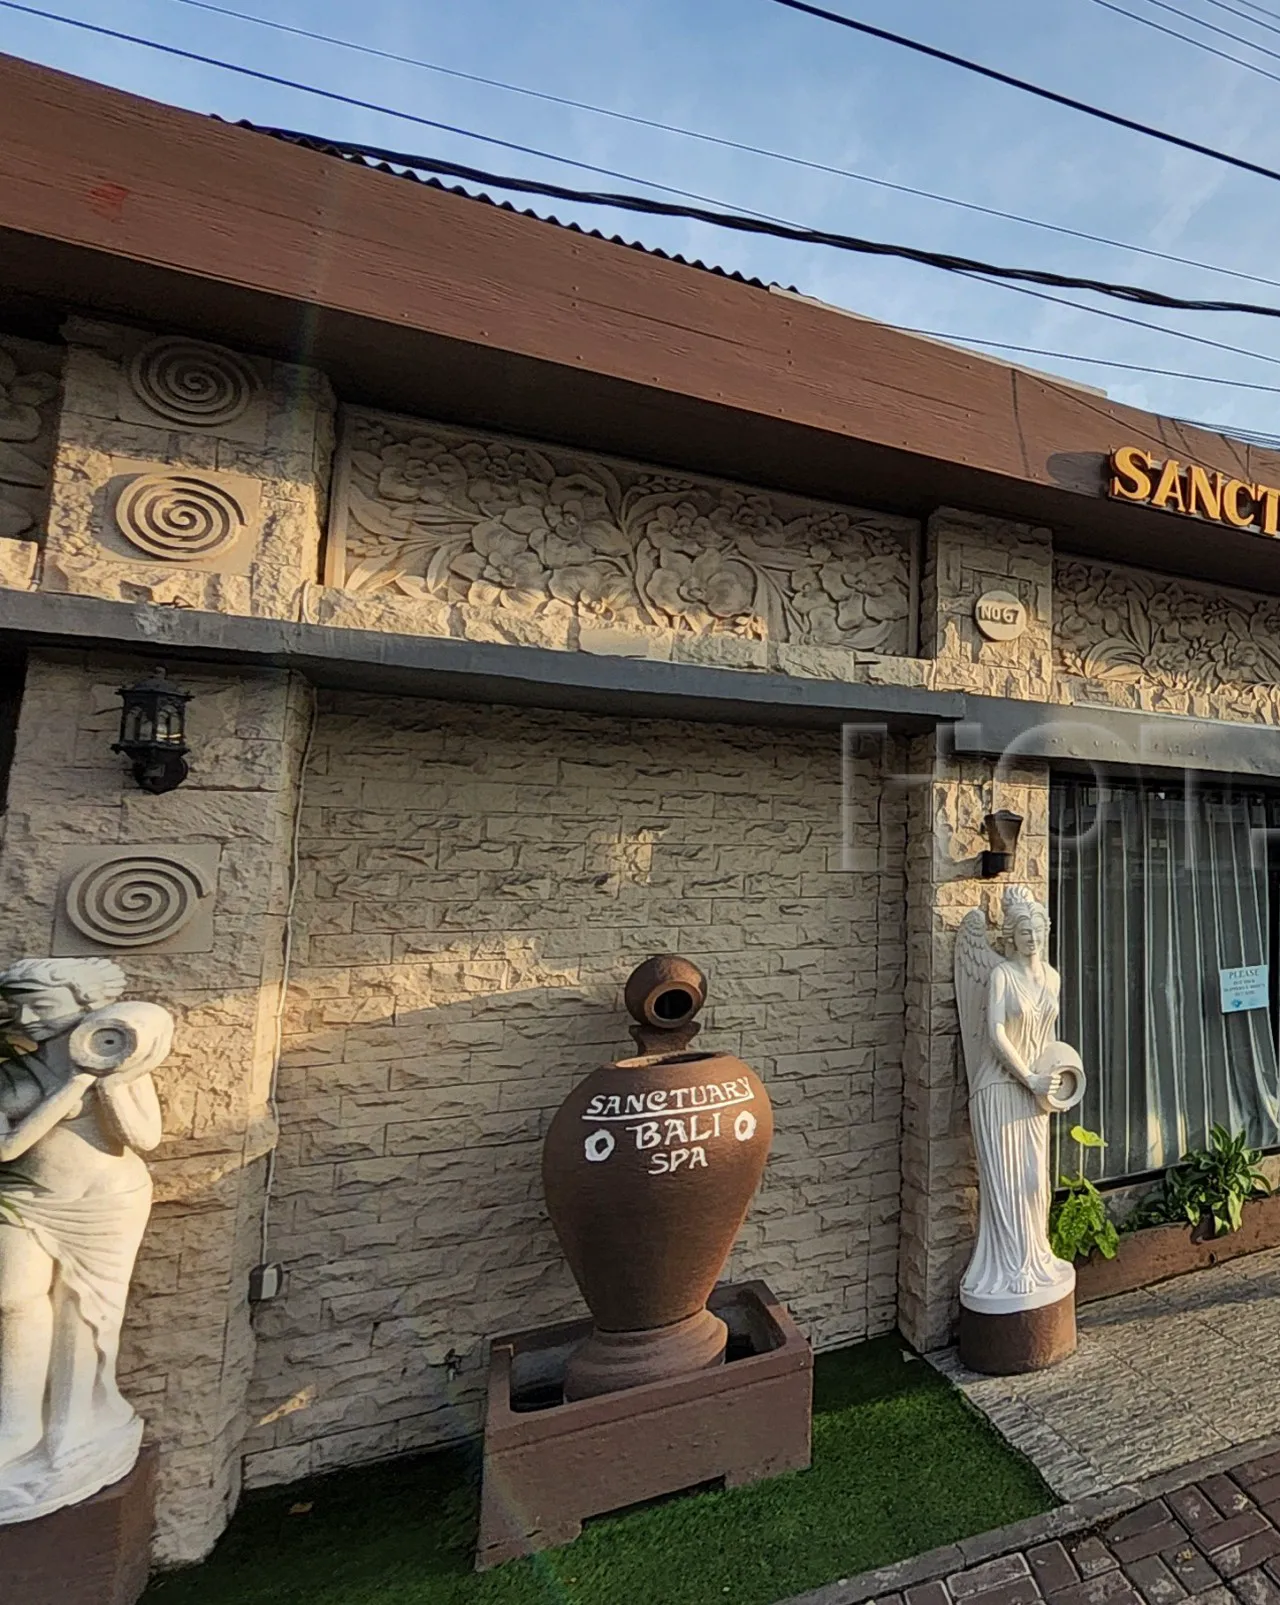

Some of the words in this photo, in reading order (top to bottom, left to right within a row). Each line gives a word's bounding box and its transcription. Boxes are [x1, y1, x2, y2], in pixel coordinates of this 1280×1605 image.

[1228, 968, 1261, 979] PLEASE
[586, 1076, 753, 1115] SANCTUARY
[626, 1112, 721, 1150] BALI
[648, 1146, 709, 1175] SPA
